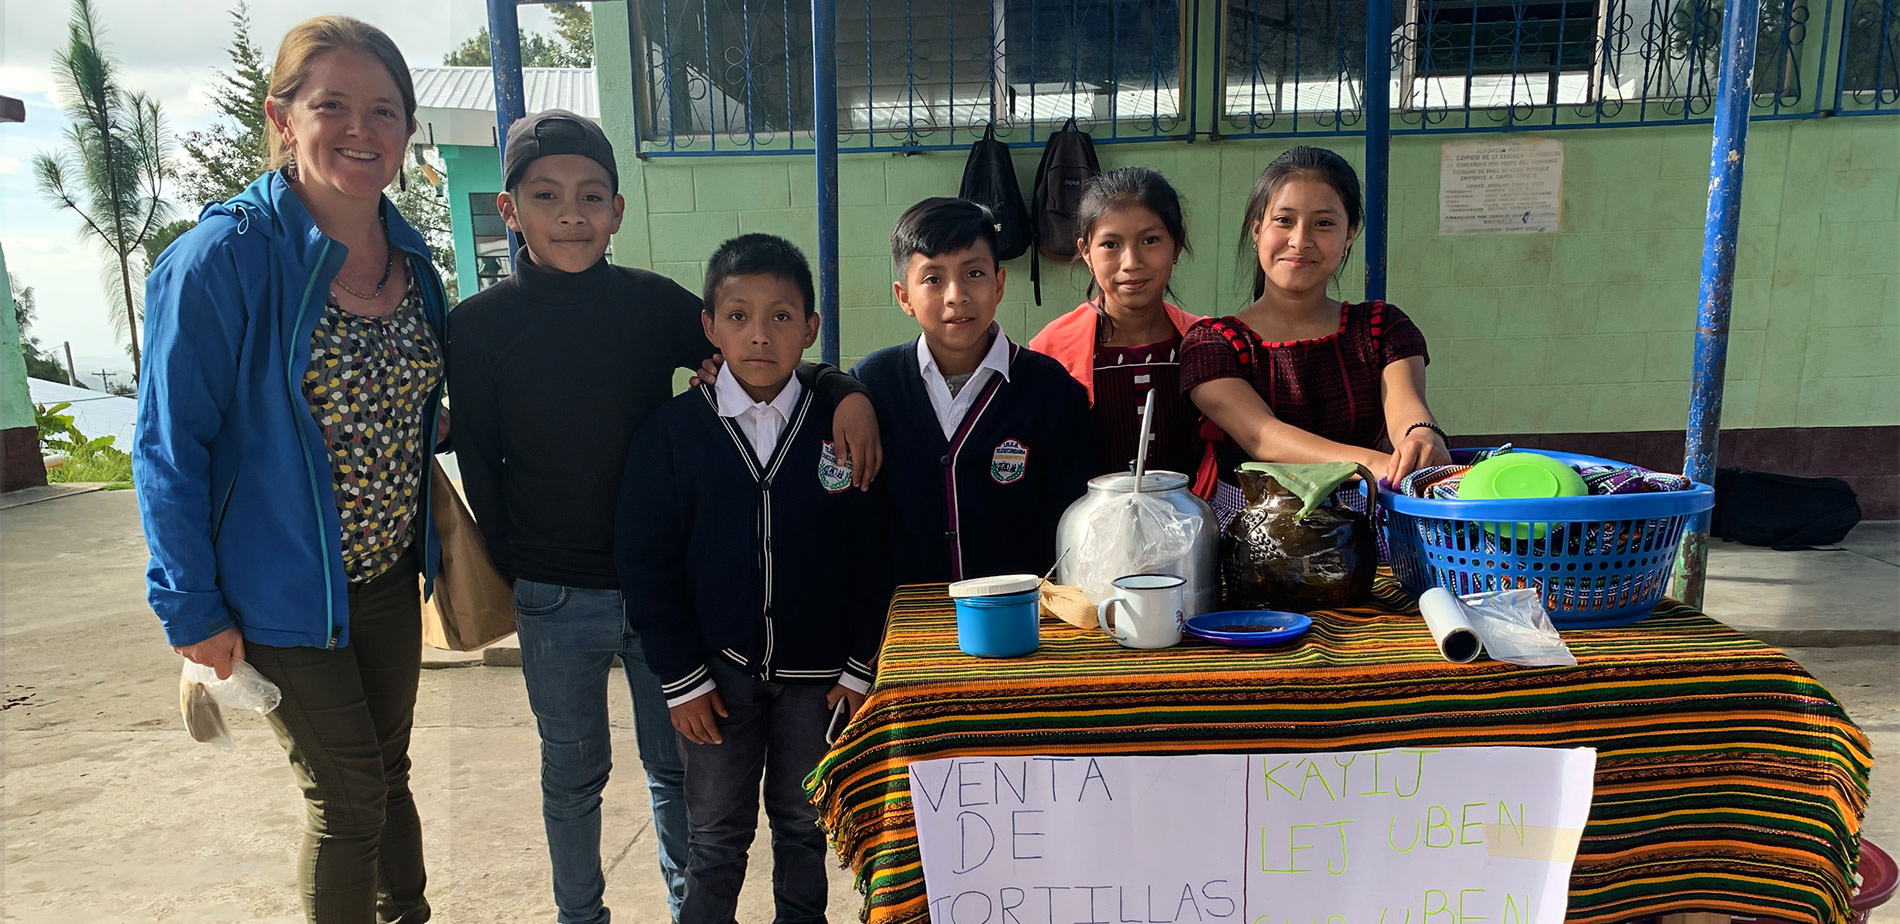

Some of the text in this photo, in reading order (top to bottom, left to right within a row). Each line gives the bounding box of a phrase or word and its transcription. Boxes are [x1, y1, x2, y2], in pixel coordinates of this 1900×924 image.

[911, 757, 1112, 812] VENTA
[952, 810, 1045, 874] DE
[1388, 800, 1524, 853] UBEN
[929, 879, 1236, 924] TORTILLAS
